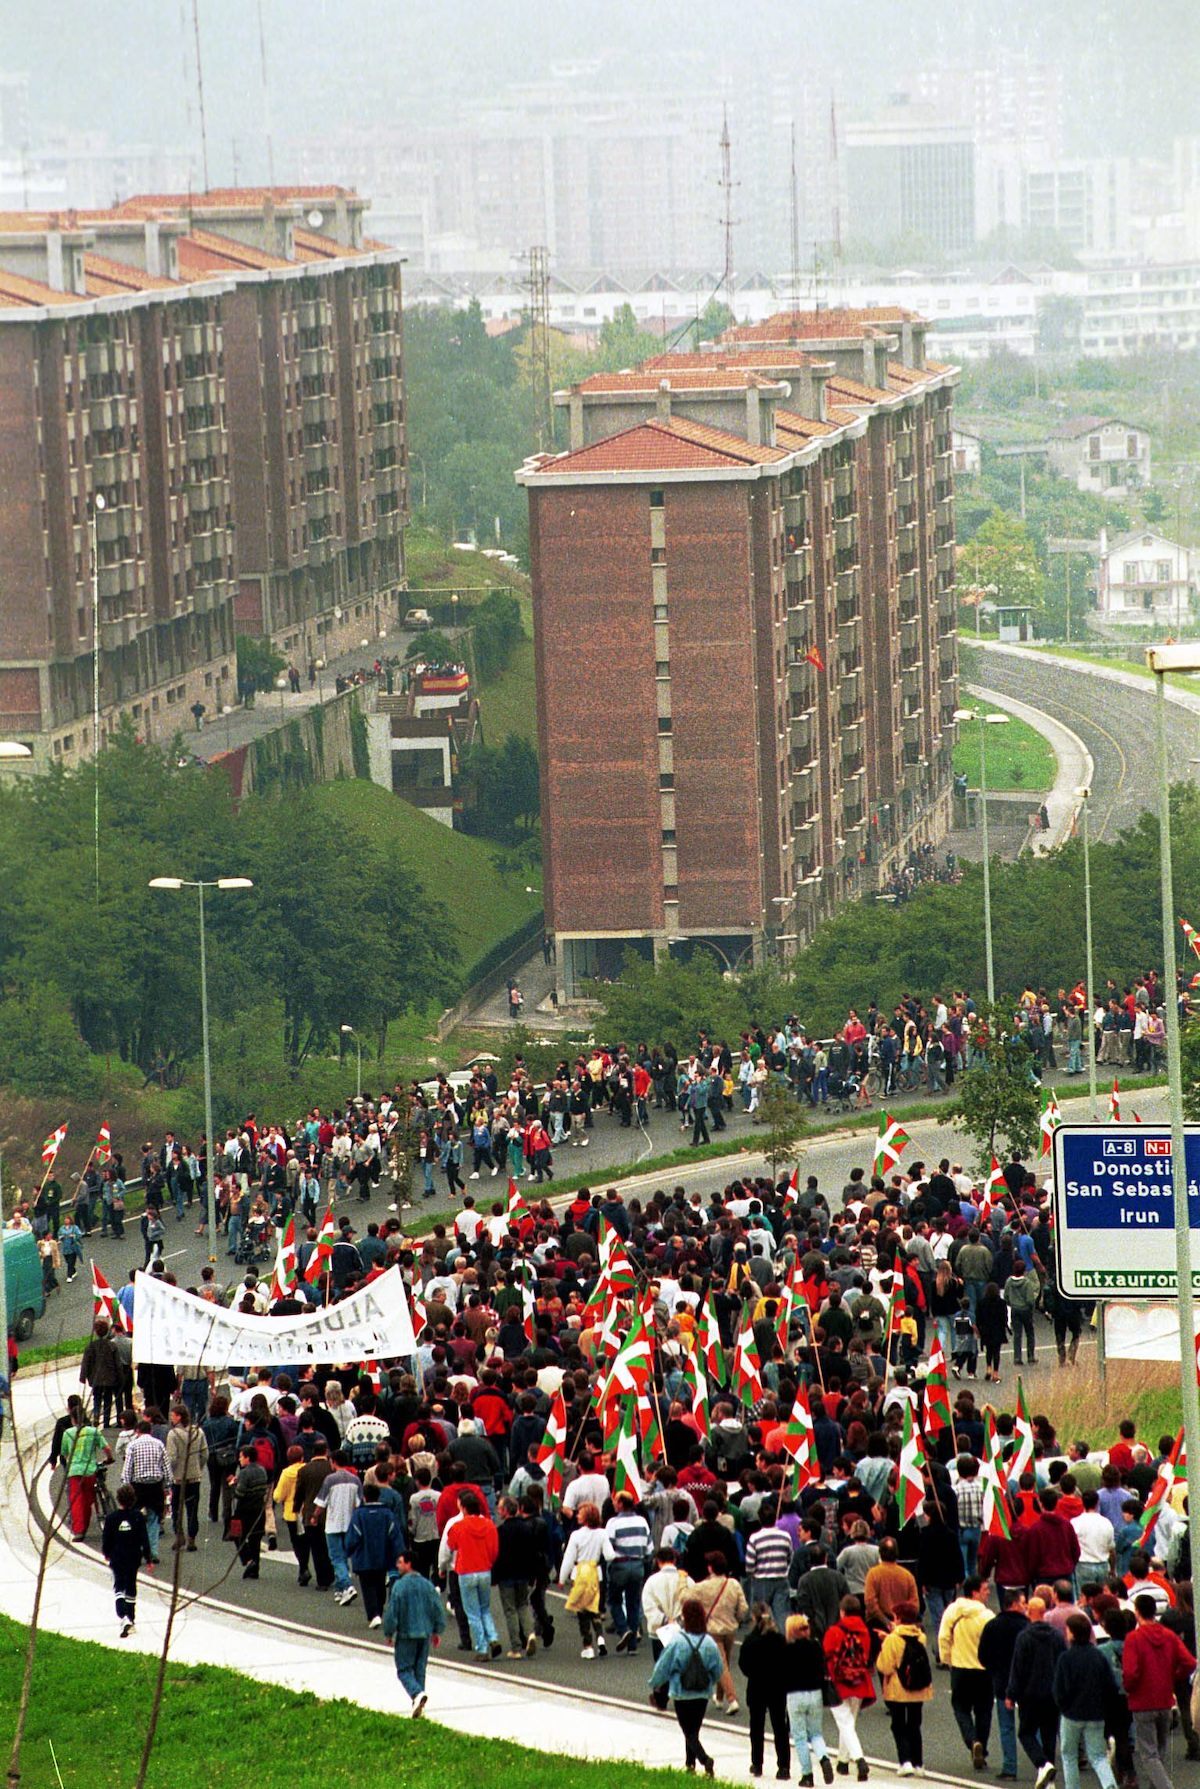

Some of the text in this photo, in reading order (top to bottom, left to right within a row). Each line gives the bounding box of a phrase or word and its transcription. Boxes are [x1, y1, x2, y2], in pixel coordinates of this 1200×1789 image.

[1106, 1142, 1133, 1154] A-8
[1093, 1159, 1175, 1176] Donosti
[1066, 1180, 1200, 1197] San Sebasá
[1120, 1208, 1160, 1223] Irun
[1076, 1271, 1200, 1287] Intxaurrono
